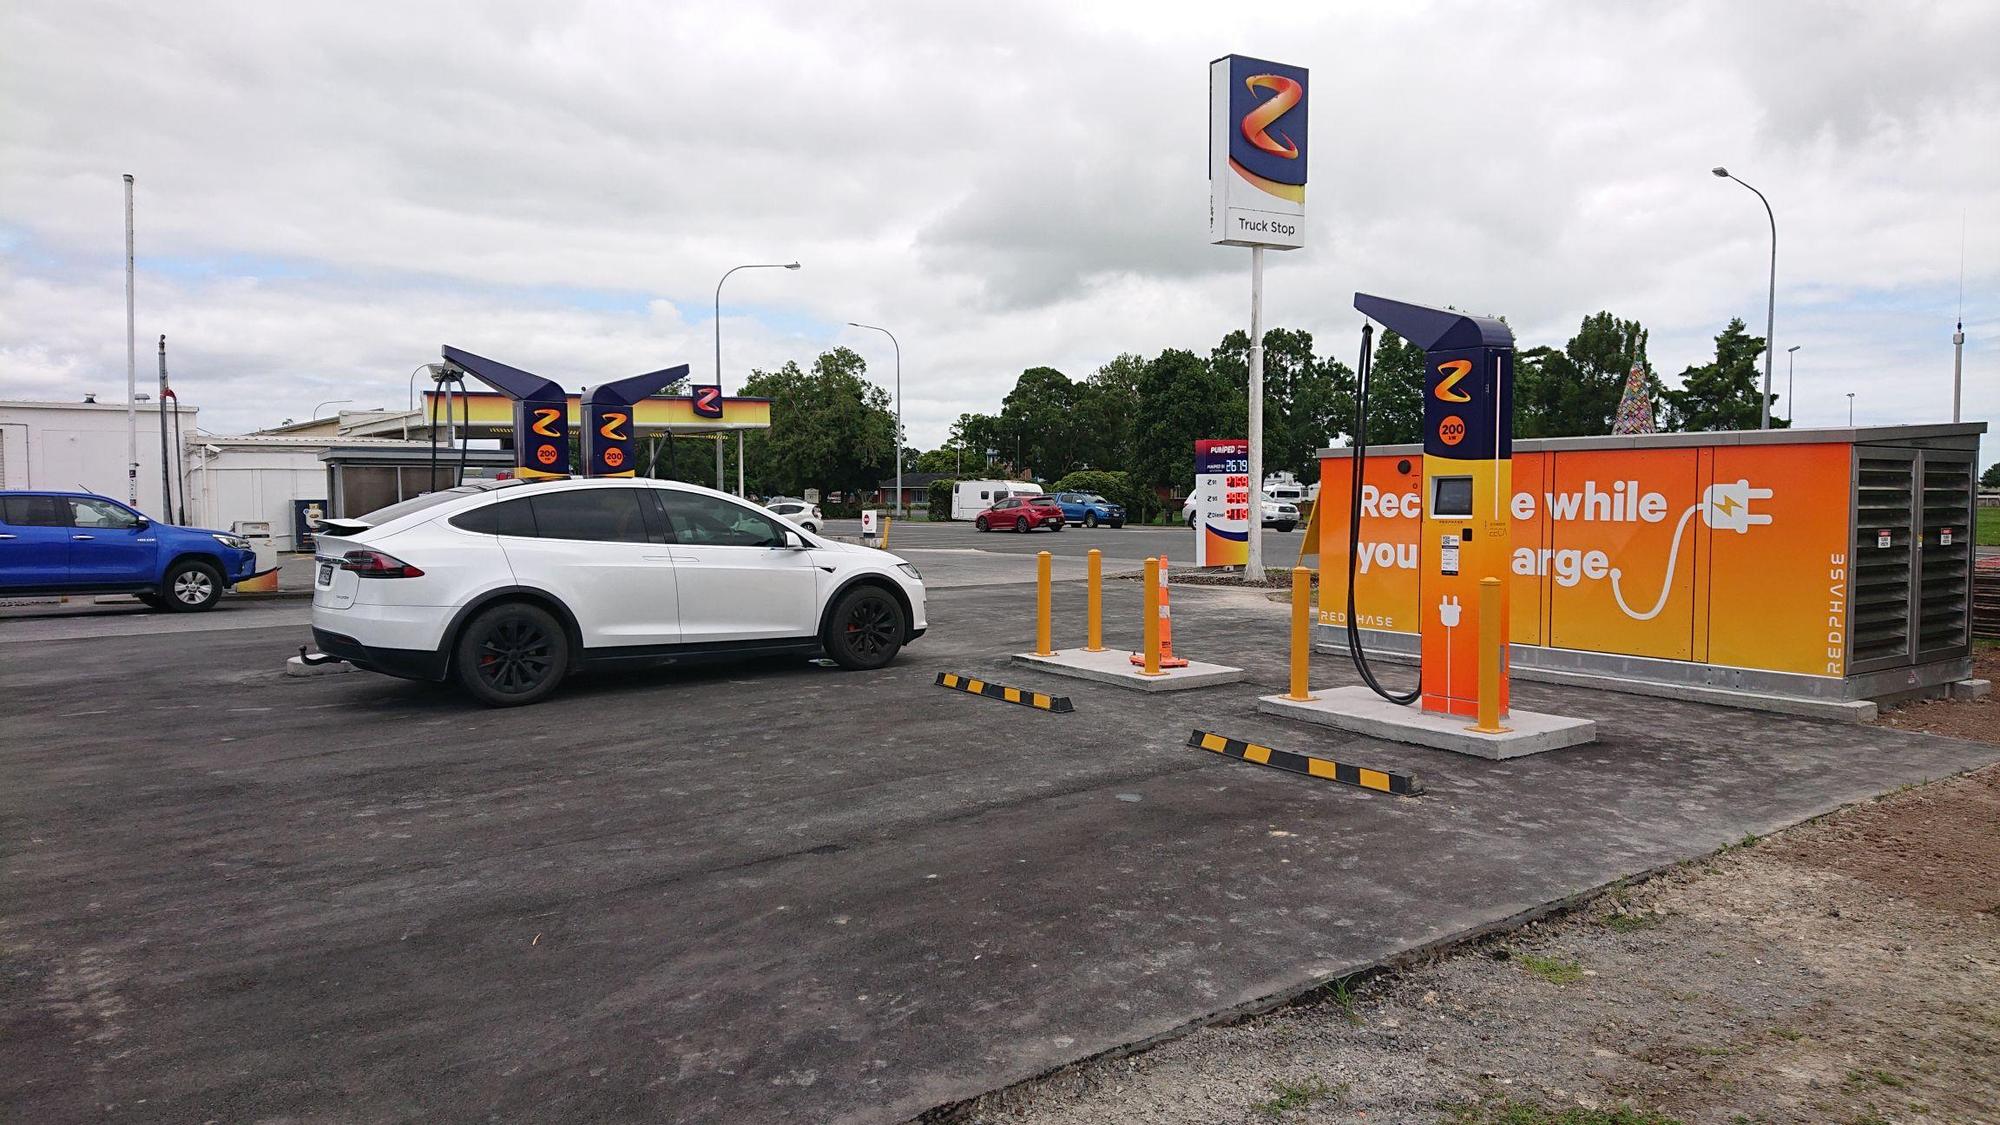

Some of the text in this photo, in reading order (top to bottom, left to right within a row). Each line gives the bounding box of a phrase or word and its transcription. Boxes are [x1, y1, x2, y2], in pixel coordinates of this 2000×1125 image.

[1240, 75, 1303, 160] Z
[1239, 217, 1295, 237] Truck Stop
[1441, 424, 1464, 435] 200
[540, 449, 556, 458] 200
[606, 452, 622, 460] 200
[1210, 445, 1236, 454] PUMPED
[1545, 480, 1668, 523] while
[1357, 542, 1418, 574] you
[1320, 610, 1393, 627] REDHASE
[1827, 553, 1845, 674] REDPHASE
